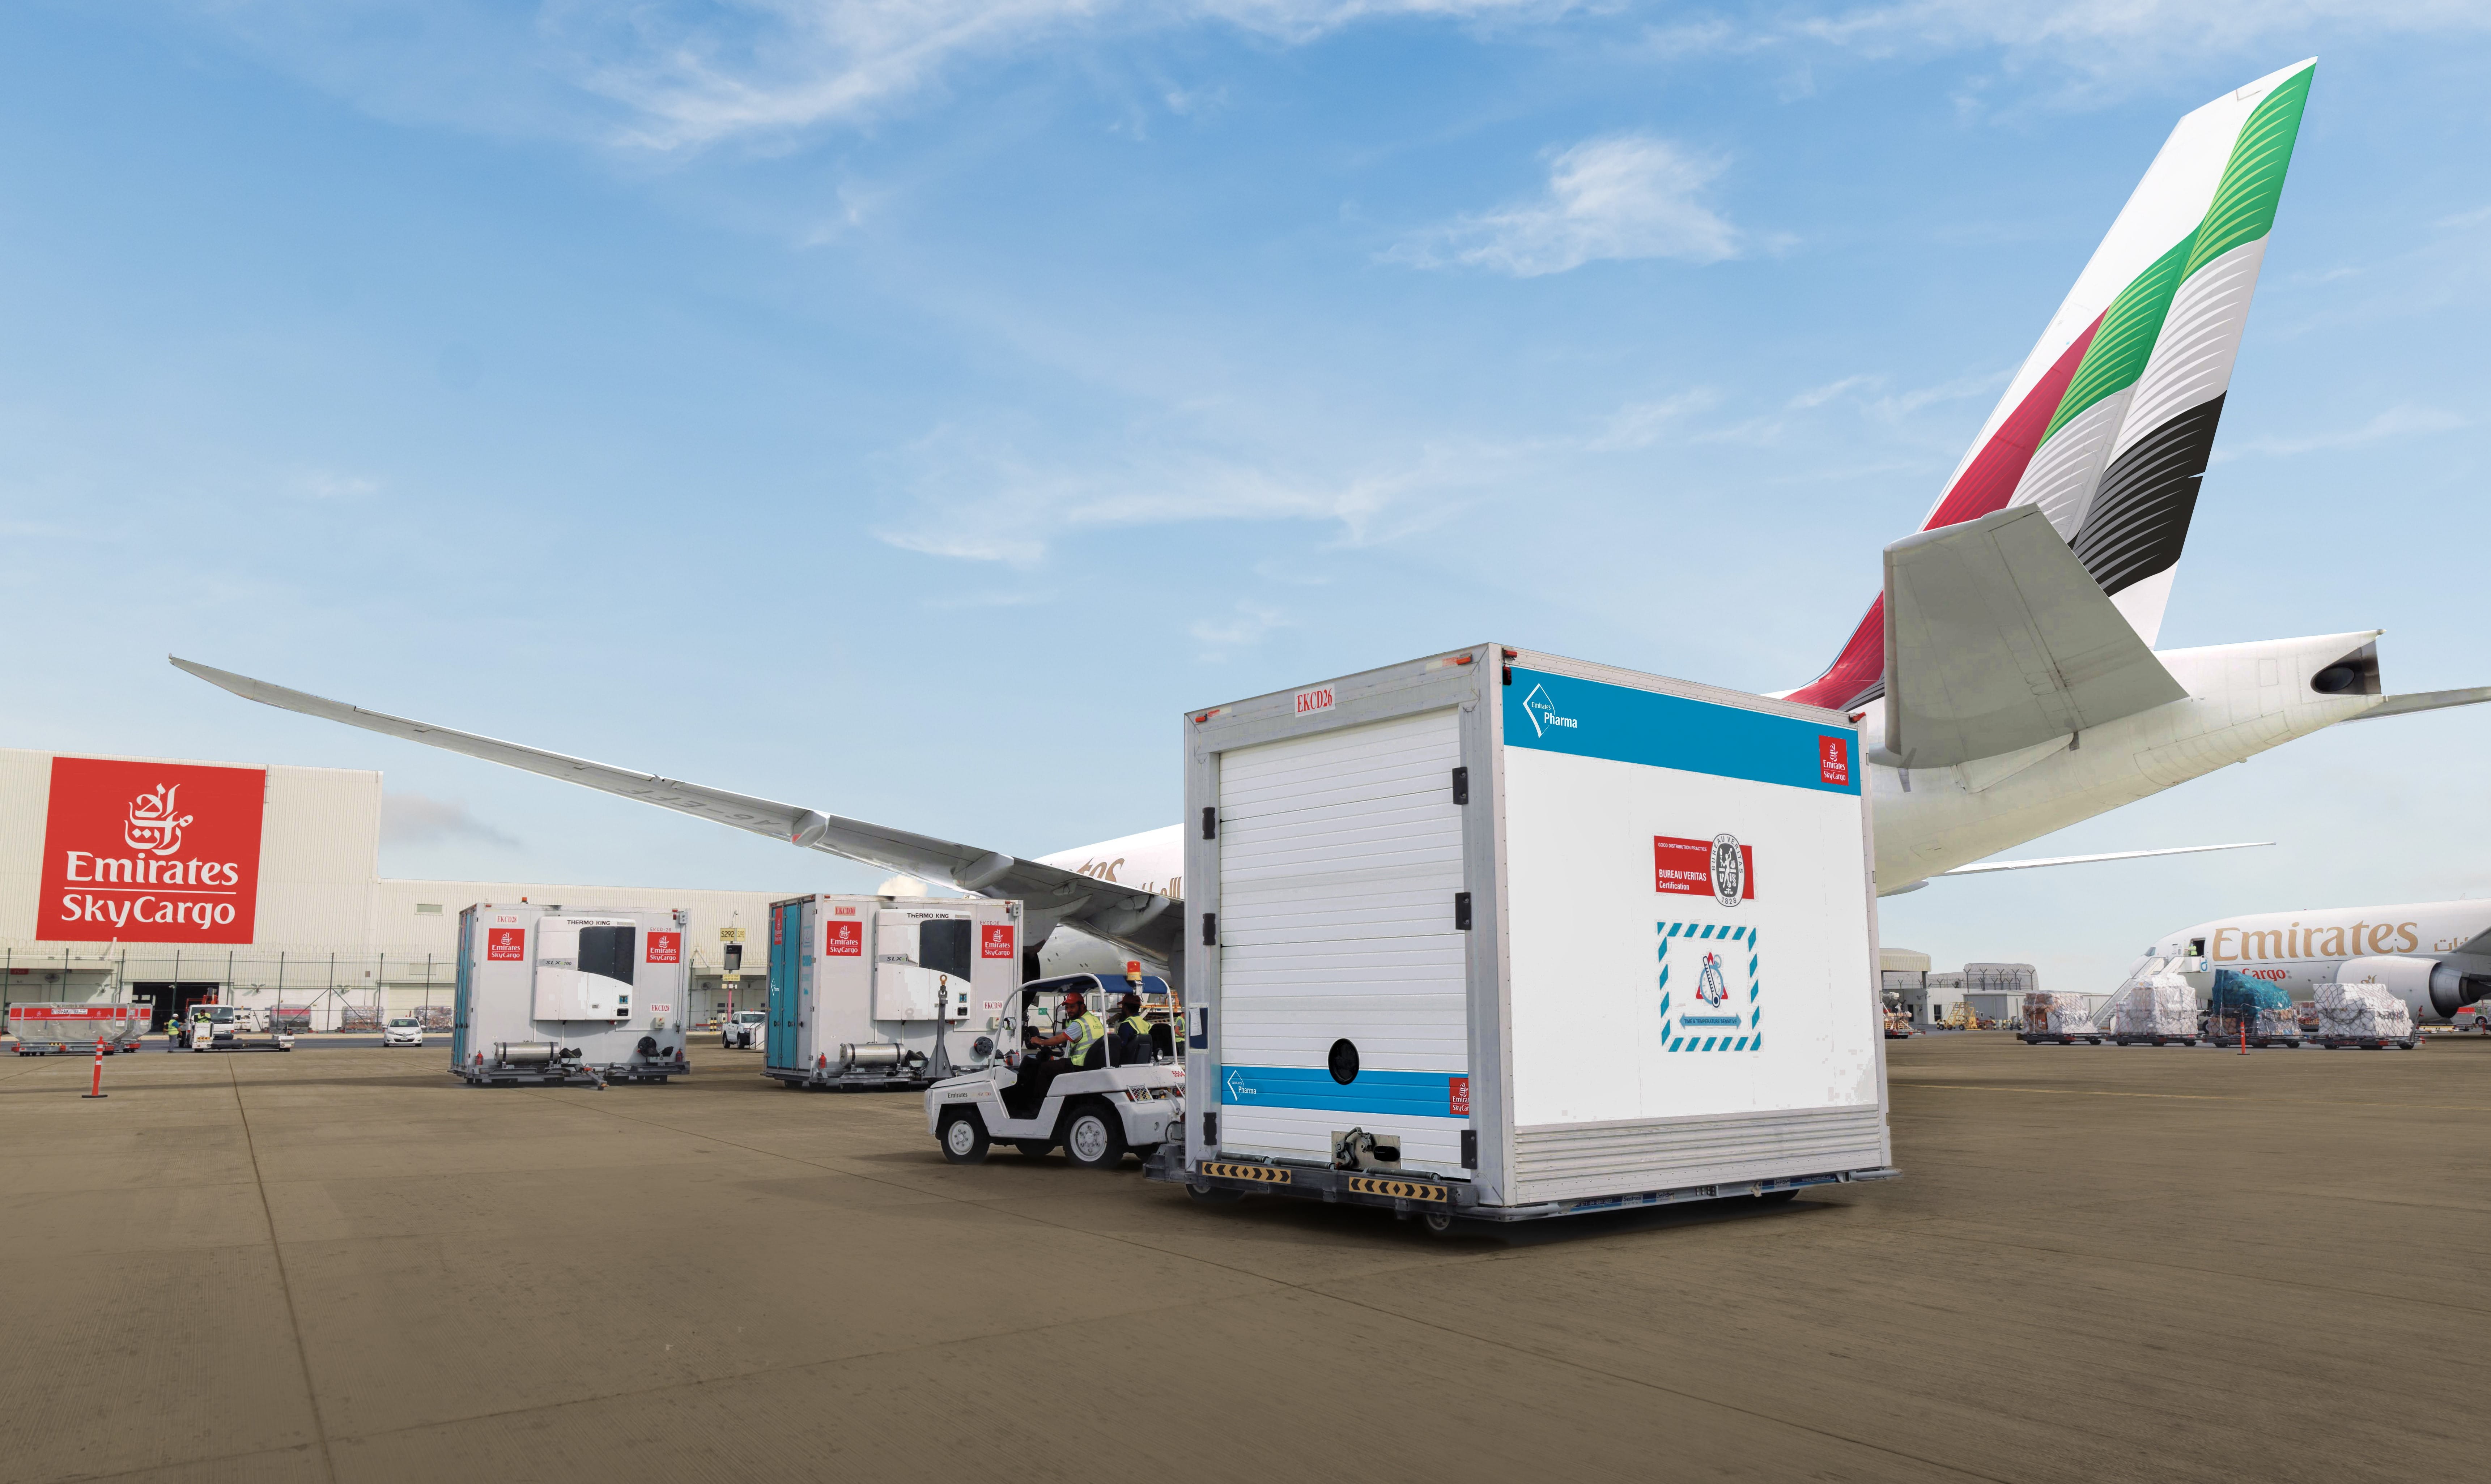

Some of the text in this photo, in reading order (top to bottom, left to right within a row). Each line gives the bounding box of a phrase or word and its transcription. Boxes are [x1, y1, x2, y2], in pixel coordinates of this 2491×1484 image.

[1297, 688, 1332, 713] EKCD26
[1531, 702, 1551, 710] Emirates
[1544, 712, 1577, 728] Pharma
[1823, 759, 1845, 771] Emirates
[1823, 771, 1846, 781] SkyCargo
[1711, 836, 1743, 874] BUREAU VERITAS
[66, 851, 238, 886] Emirates
[1659, 869, 1706, 882] BUREAU VERITAS
[1659, 880, 1689, 891] Certification
[61, 894, 235, 930] SkyCargo
[2212, 920, 2418, 961] Emirates
[2241, 968, 2286, 982] Cargo
